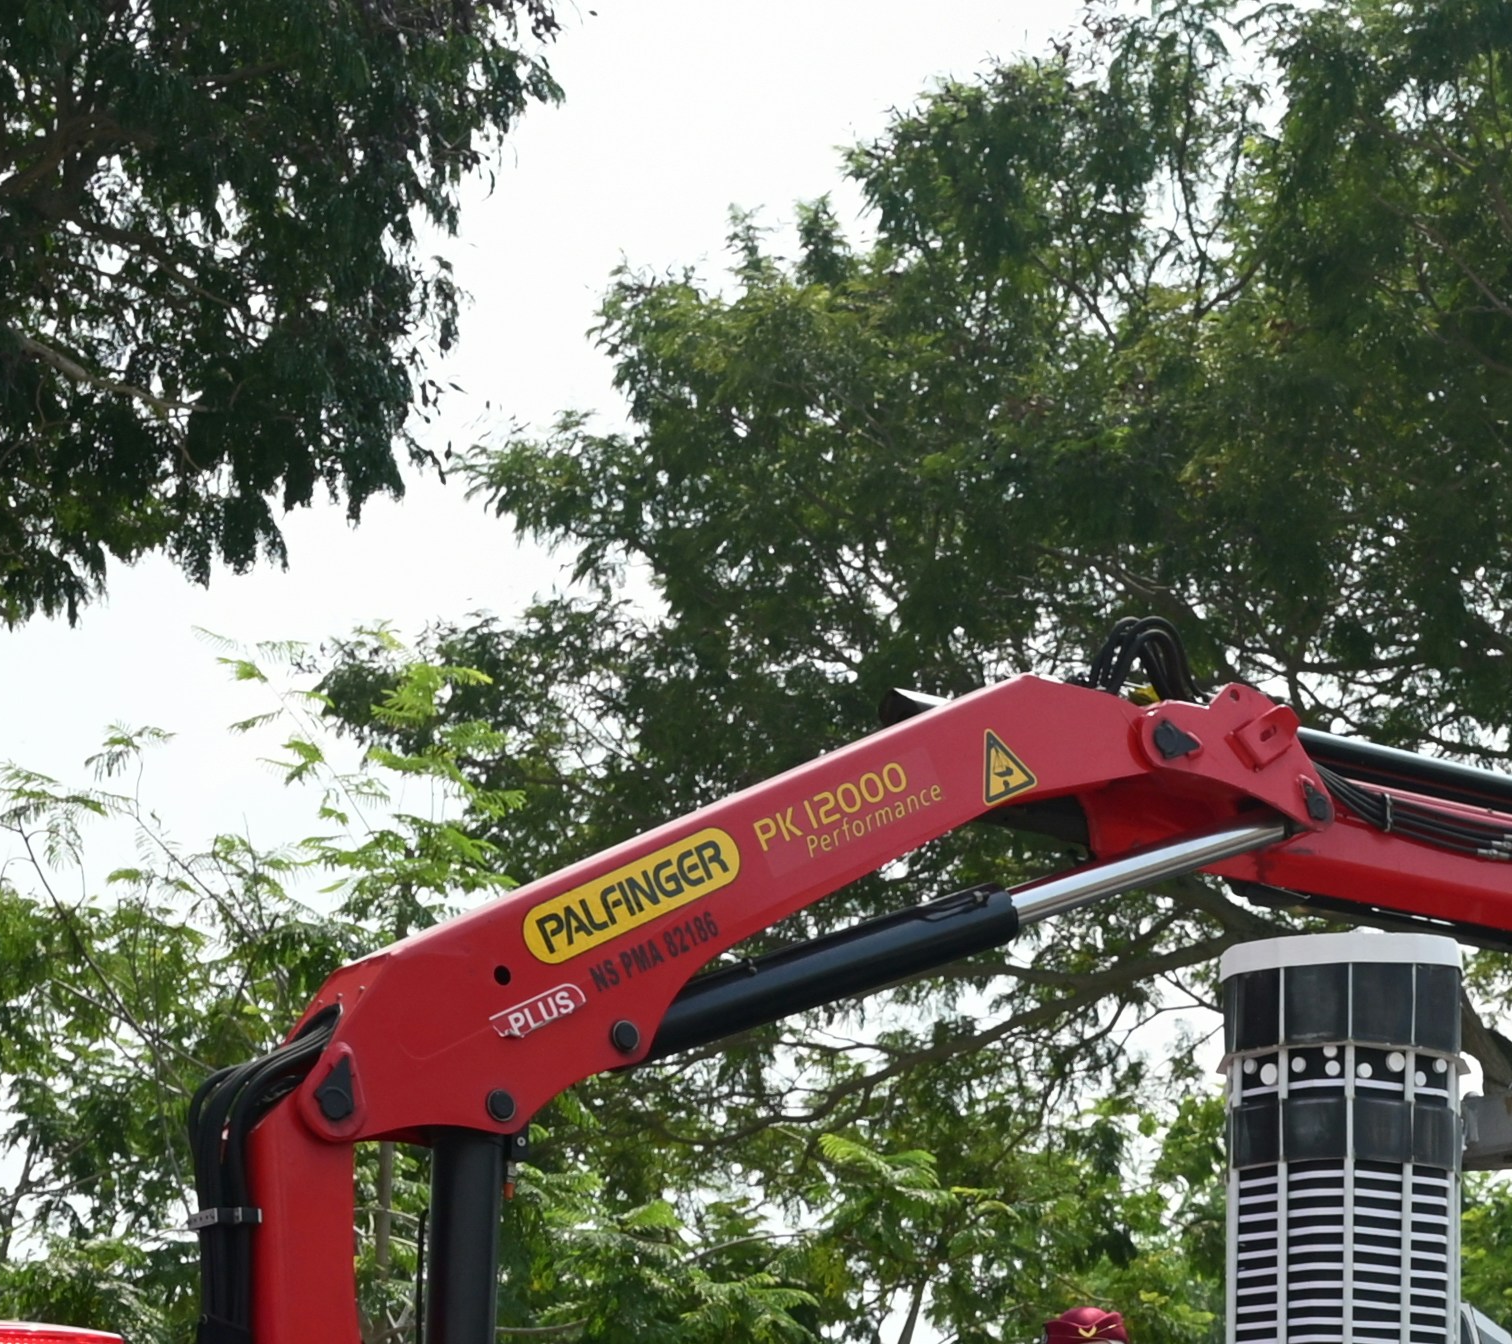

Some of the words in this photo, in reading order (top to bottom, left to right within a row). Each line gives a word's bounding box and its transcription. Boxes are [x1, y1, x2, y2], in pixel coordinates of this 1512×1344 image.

[753, 807, 803, 851] PK
[803, 762, 908, 829] 12000
[806, 784, 943, 858] Performance
[535, 840, 730, 955] PALFINGER
[588, 958, 620, 992] NS
[619, 939, 665, 978] PMA
[663, 911, 719, 958] 82186
[507, 991, 575, 1035] PLUS
